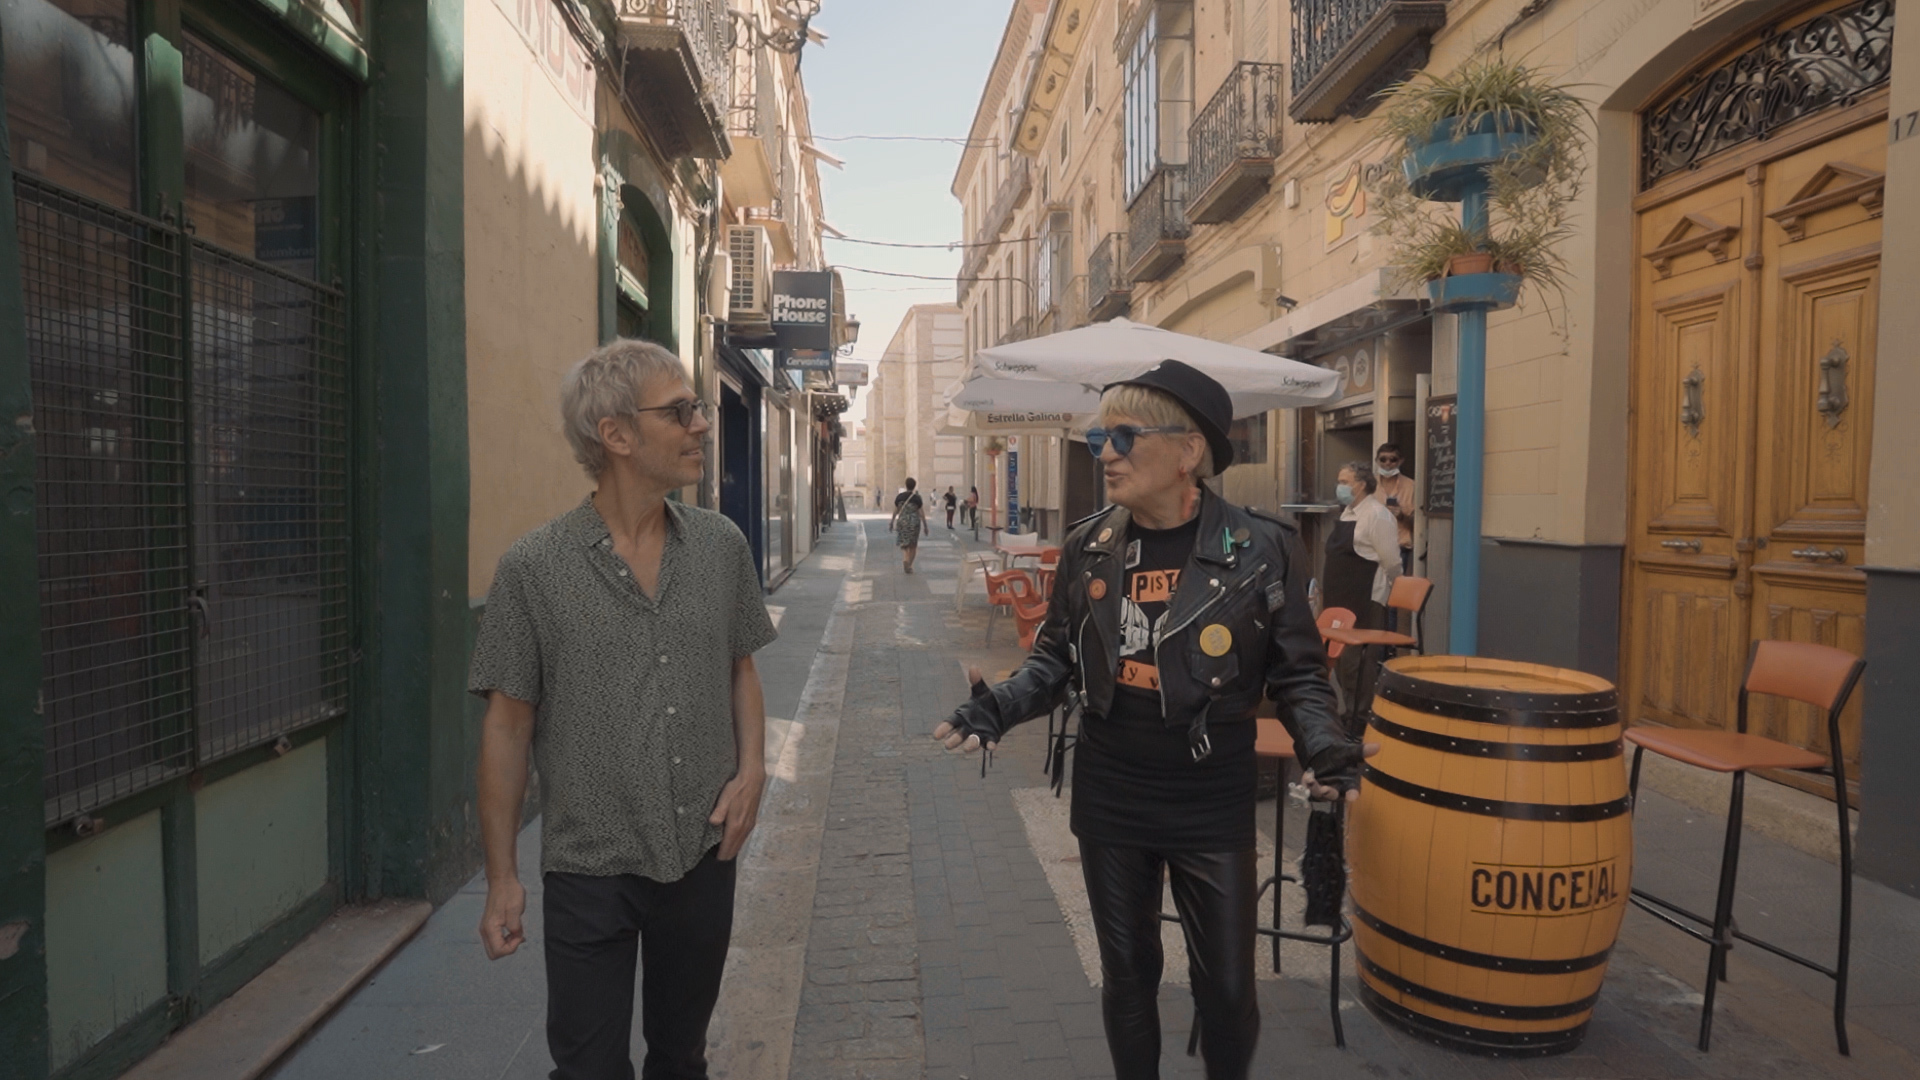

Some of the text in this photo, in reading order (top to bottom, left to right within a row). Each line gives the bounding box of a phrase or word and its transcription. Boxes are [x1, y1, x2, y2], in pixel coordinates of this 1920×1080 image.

[1894, 110, 1919, 141] 17
[773, 293, 827, 310] Phone
[773, 308, 827, 324] House
[994, 360, 1038, 374] Schweppes
[987, 411, 1061, 423] Estrella Galicia
[1136, 572, 1178, 601] PIST
[1471, 863, 1618, 912] CONCEJAL
